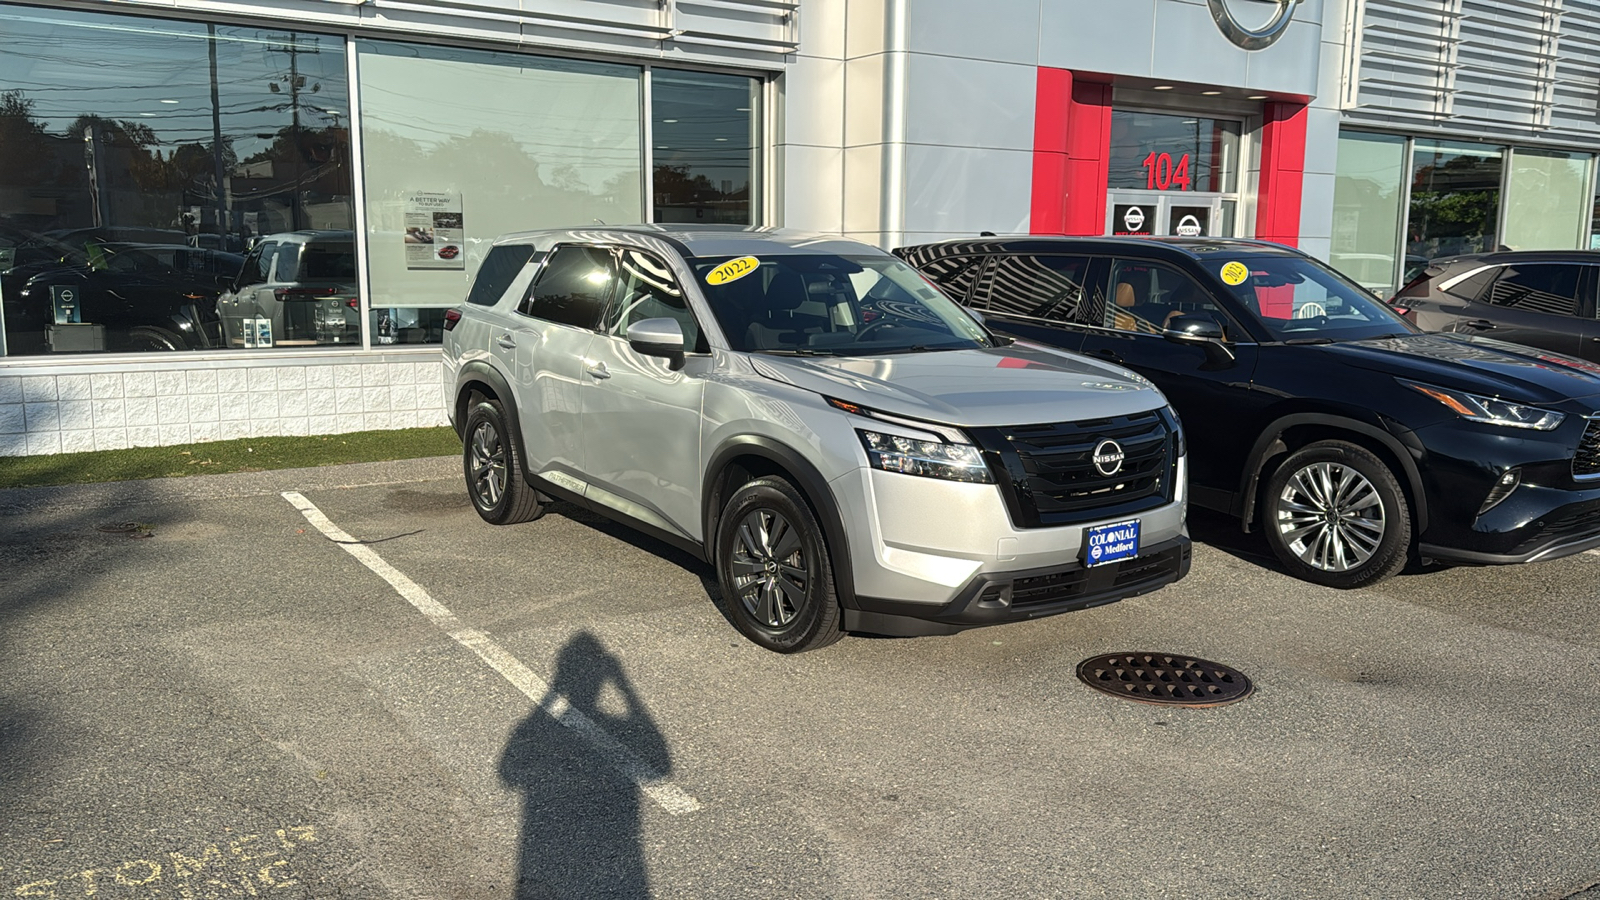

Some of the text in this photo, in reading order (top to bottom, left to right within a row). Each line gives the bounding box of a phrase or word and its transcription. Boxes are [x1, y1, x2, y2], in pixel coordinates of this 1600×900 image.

[1143, 152, 1191, 191] 104
[715, 259, 751, 282] 2022
[1092, 452, 1125, 464] NISSAN
[1089, 528, 1137, 547] COLONIAL
[1104, 541, 1134, 555] Medford
